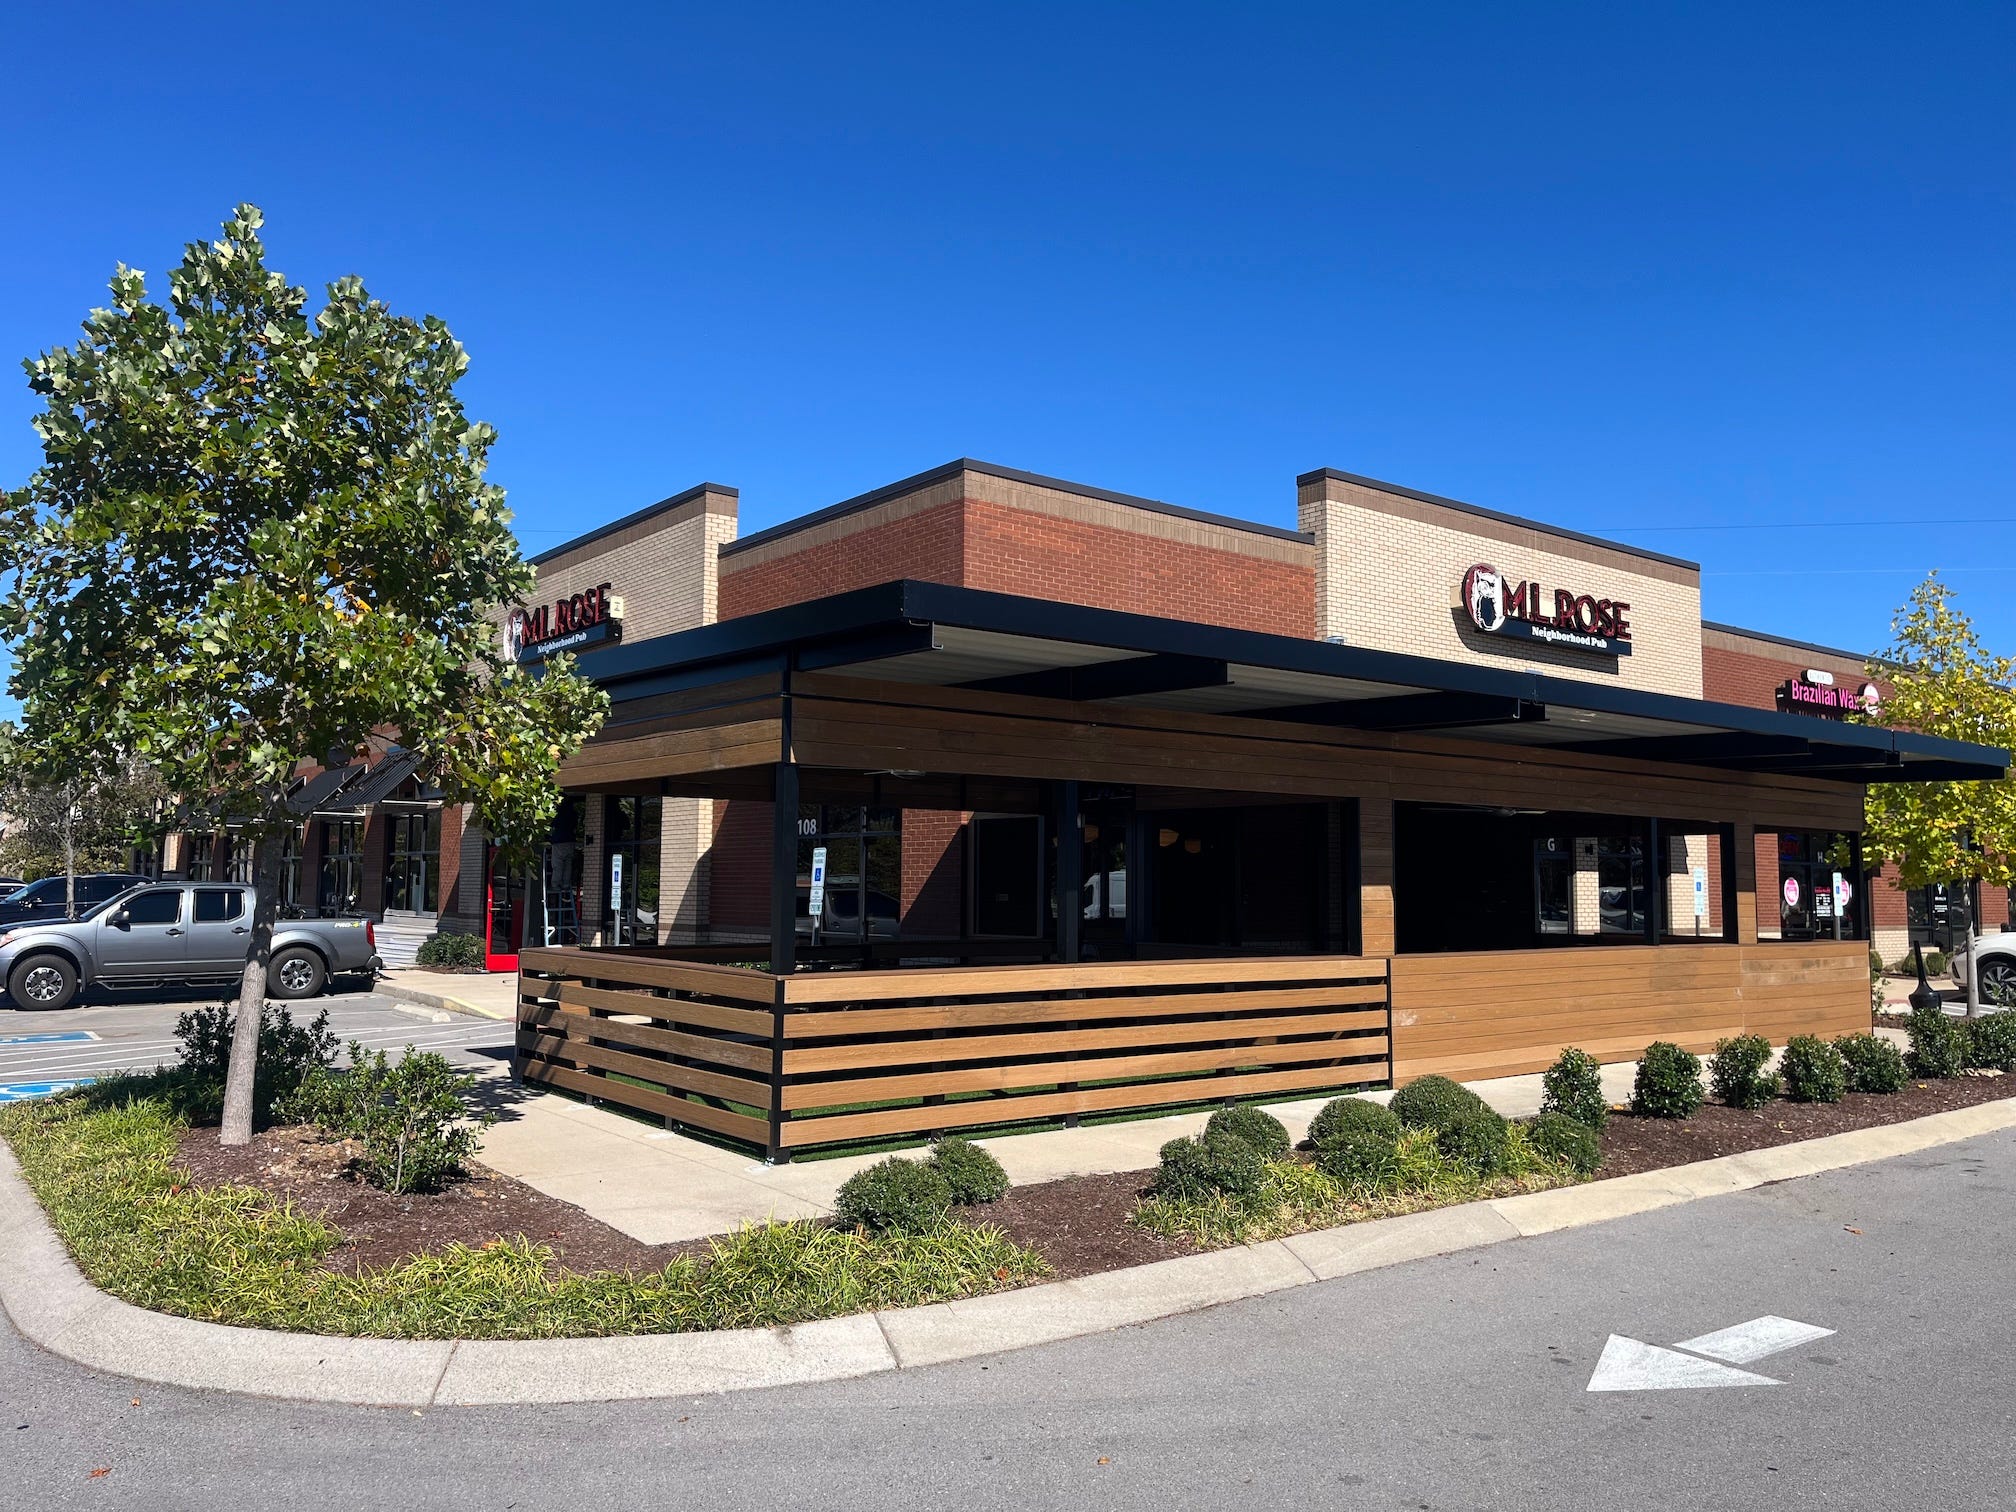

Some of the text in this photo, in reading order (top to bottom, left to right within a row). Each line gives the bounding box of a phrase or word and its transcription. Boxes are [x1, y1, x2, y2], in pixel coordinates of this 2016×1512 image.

[1531, 625, 1608, 649] Neighborhood Pub
[1792, 679, 1860, 711] Brazilian Wax
[798, 818, 816, 835] 108
[1547, 838, 1555, 852] G
[1817, 851, 1823, 863] H
